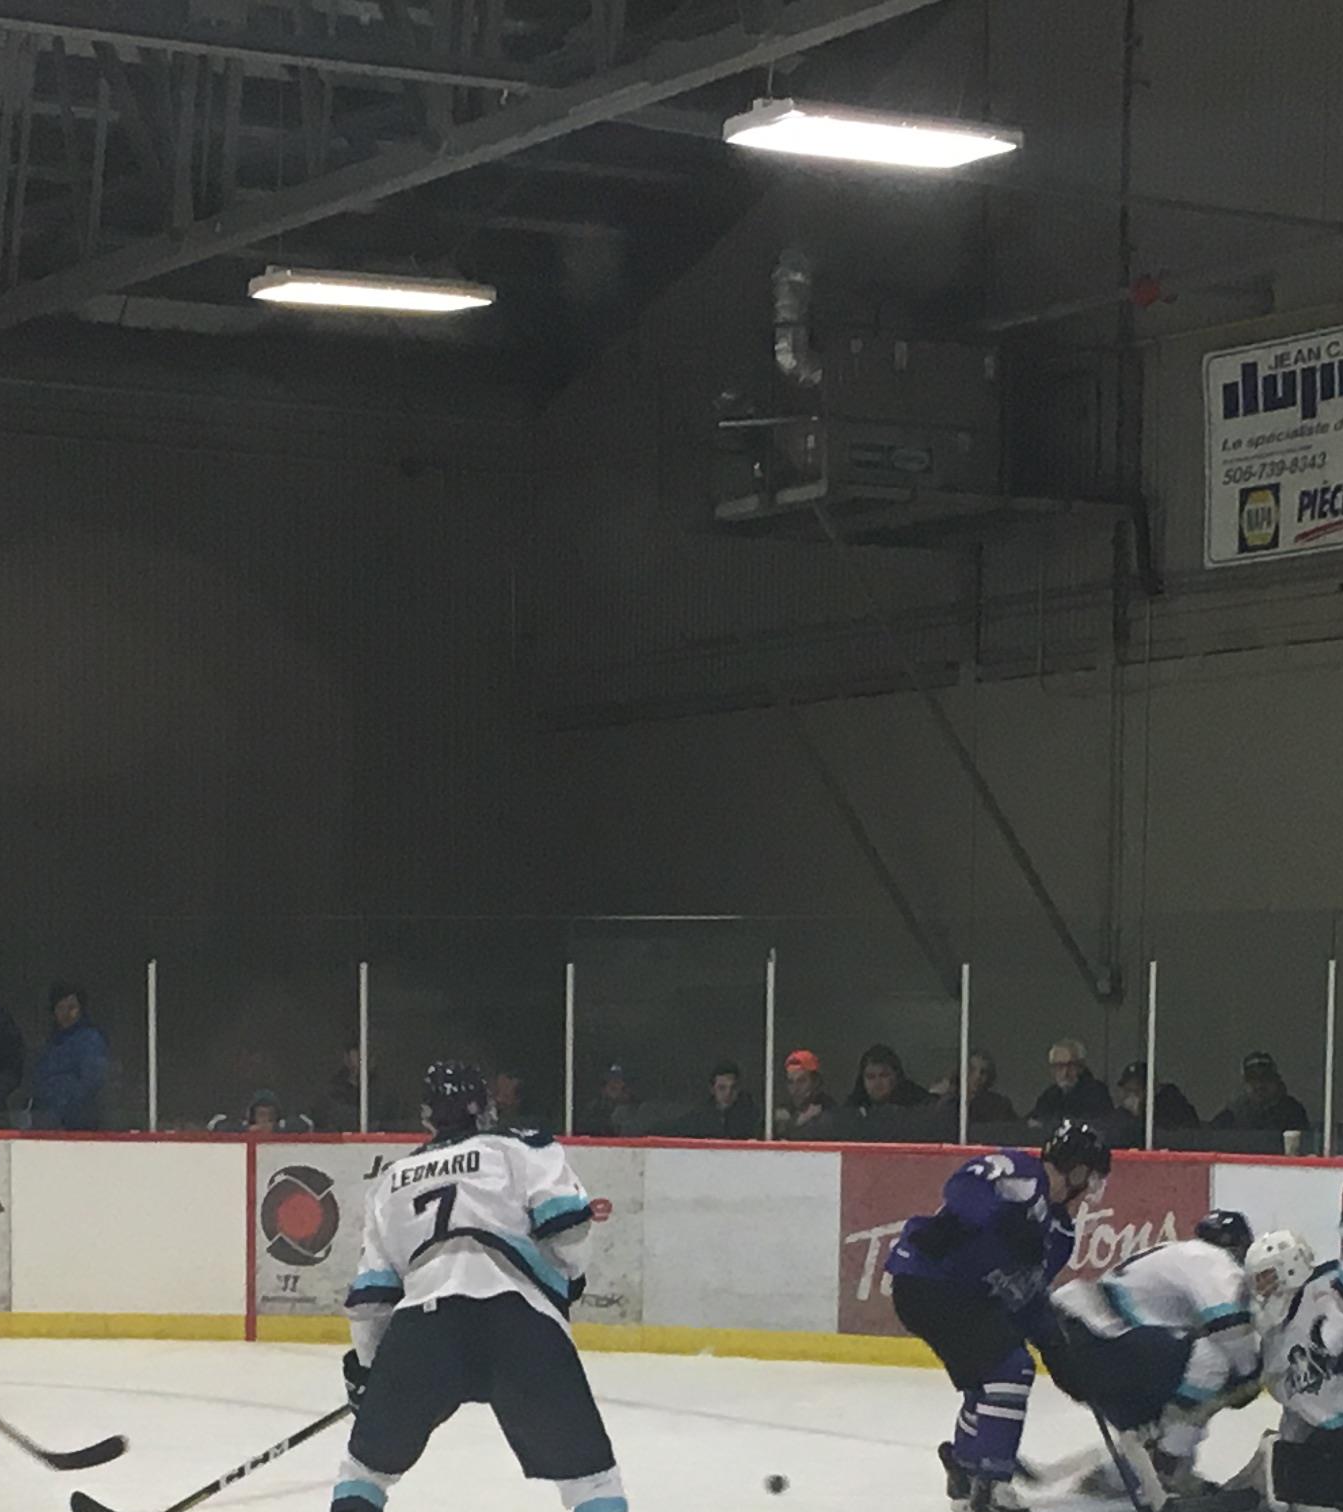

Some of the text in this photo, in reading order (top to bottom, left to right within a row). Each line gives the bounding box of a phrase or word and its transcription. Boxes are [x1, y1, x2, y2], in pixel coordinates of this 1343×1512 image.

[1268, 344, 1321, 371] JEAN
[390, 1150, 481, 1193] LEONARD
[413, 1182, 459, 1241] 7
